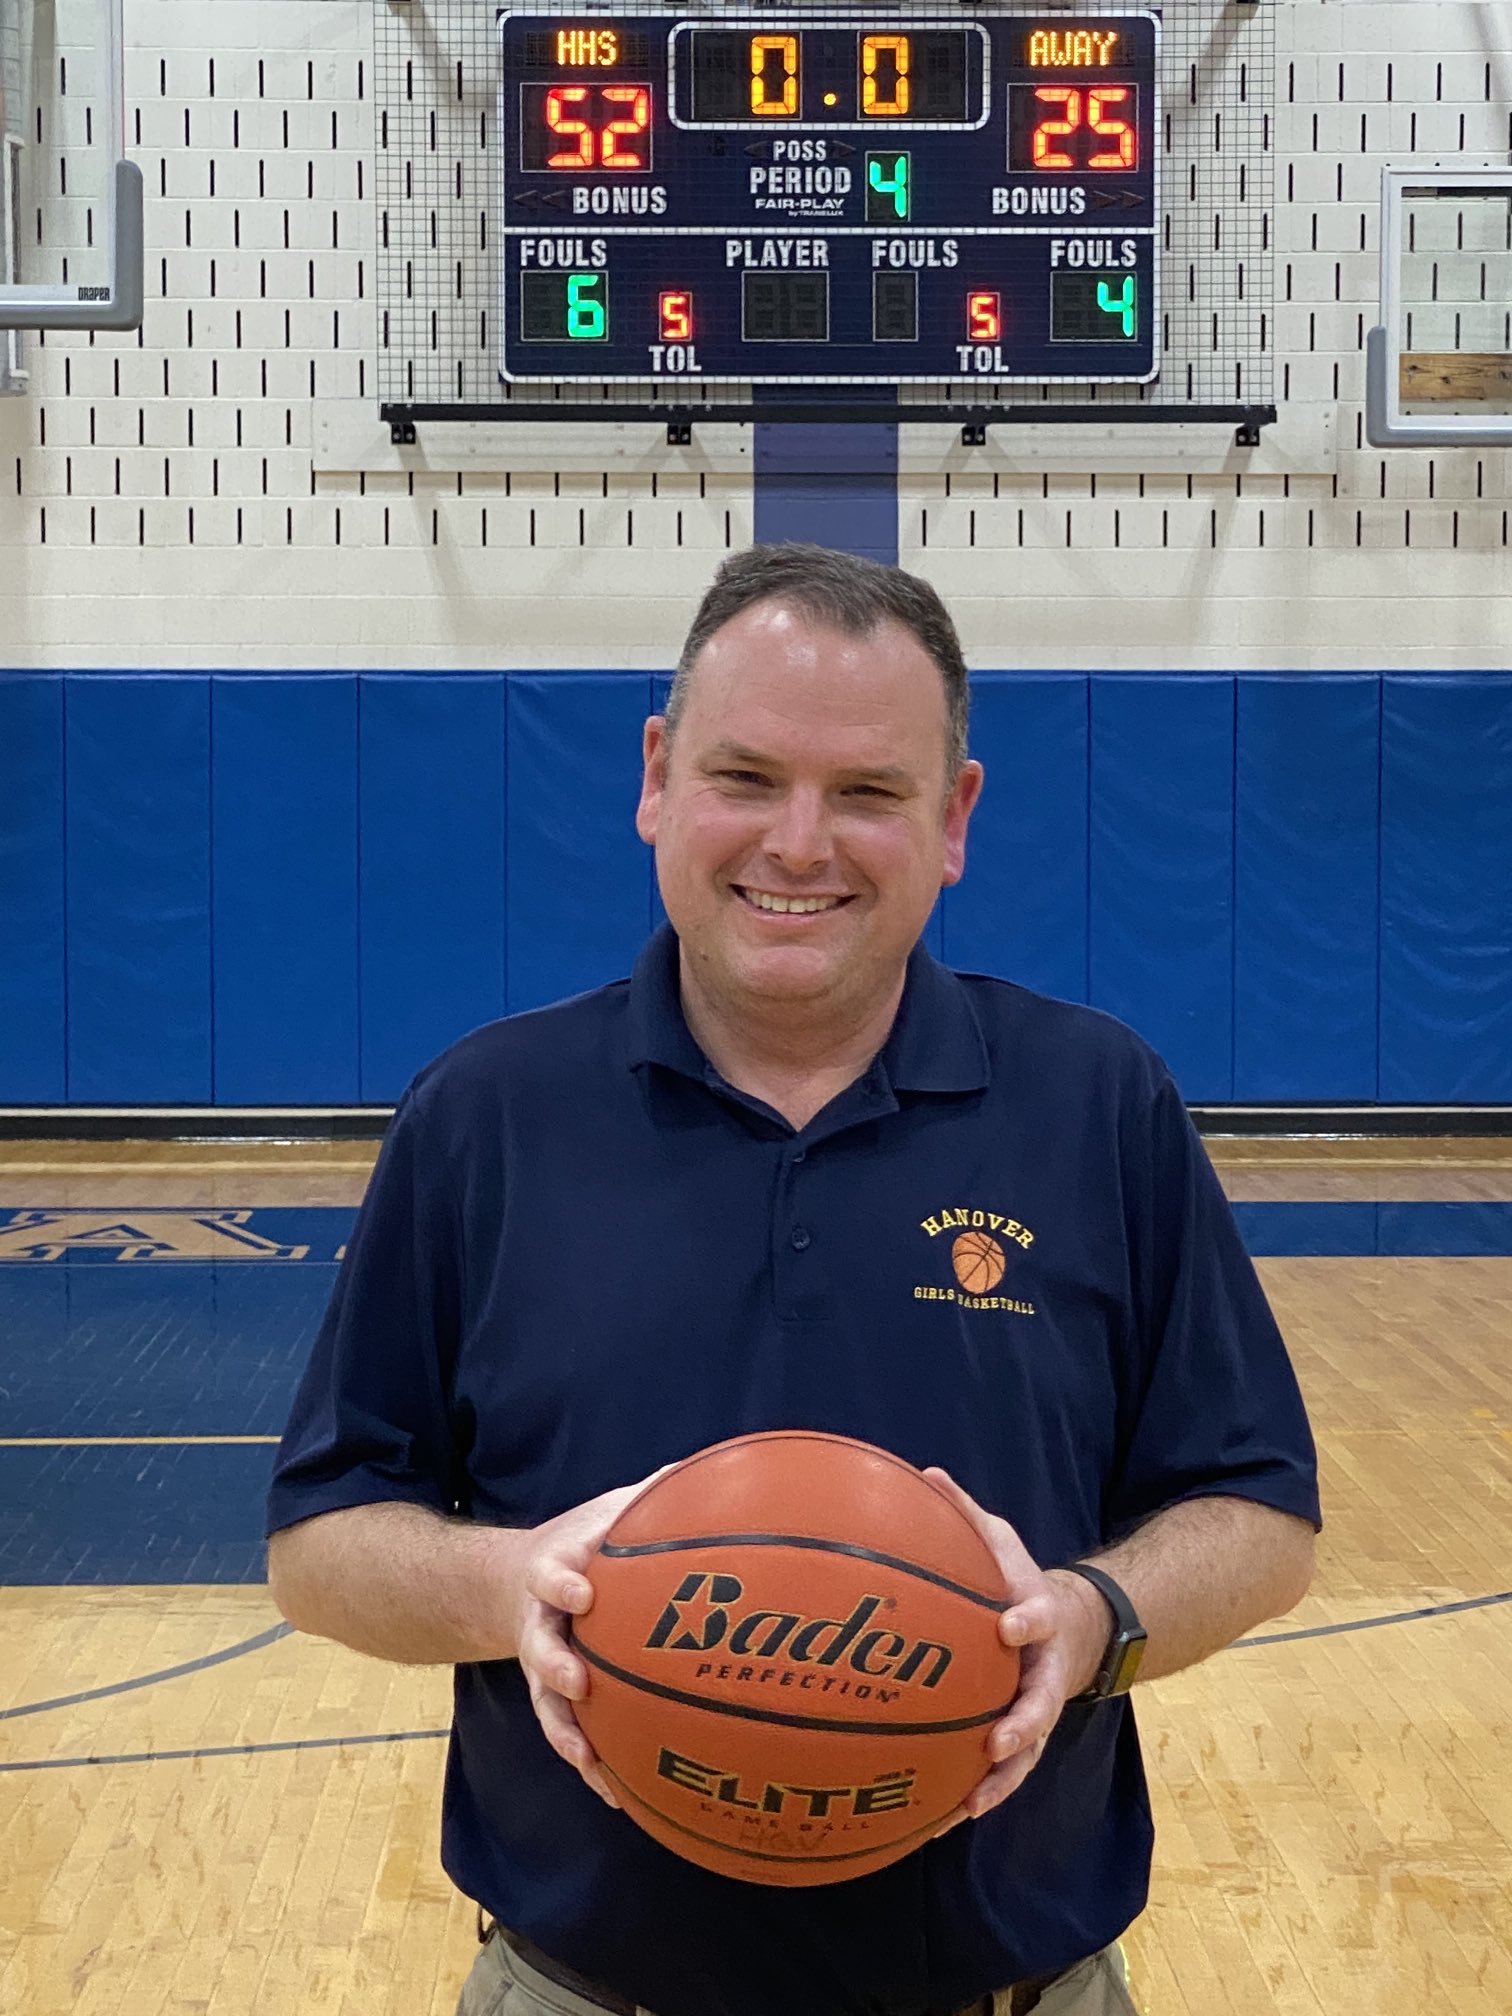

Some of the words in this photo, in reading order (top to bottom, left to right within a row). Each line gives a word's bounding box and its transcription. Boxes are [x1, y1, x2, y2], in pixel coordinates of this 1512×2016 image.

[557, 30, 617, 66] HHS
[1030, 31, 1117, 66] AWAY
[547, 88, 648, 168] 52
[1033, 88, 1134, 168] 25
[773, 140, 827, 161] POSS
[750, 166, 851, 194] PERIOD
[869, 156, 906, 218] 4
[572, 187, 668, 215] BONUS
[755, 198, 844, 209] FAIR-PLAY
[991, 187, 1086, 215] BONUS
[520, 239, 607, 267] FOULS
[726, 239, 829, 267] PLAYER
[872, 239, 958, 267] FOULS
[1050, 239, 1137, 267] FOULS
[78, 287, 110, 300] DRAPER
[567, 274, 604, 338] 6
[1097, 276, 1134, 337] 4
[662, 295, 689, 338] 5
[970, 295, 997, 338] 5
[648, 345, 702, 372] TOL
[956, 345, 1009, 372] TOL
[920, 1208, 1034, 1249] HANOVER
[914, 1287, 955, 1300] GIRLS
[958, 1294, 1035, 1314] BASKETBALL
[643, 1572, 953, 1688] Baden
[695, 1663, 900, 1703] PERFECTION
[656, 1746, 915, 1817] ELITE
